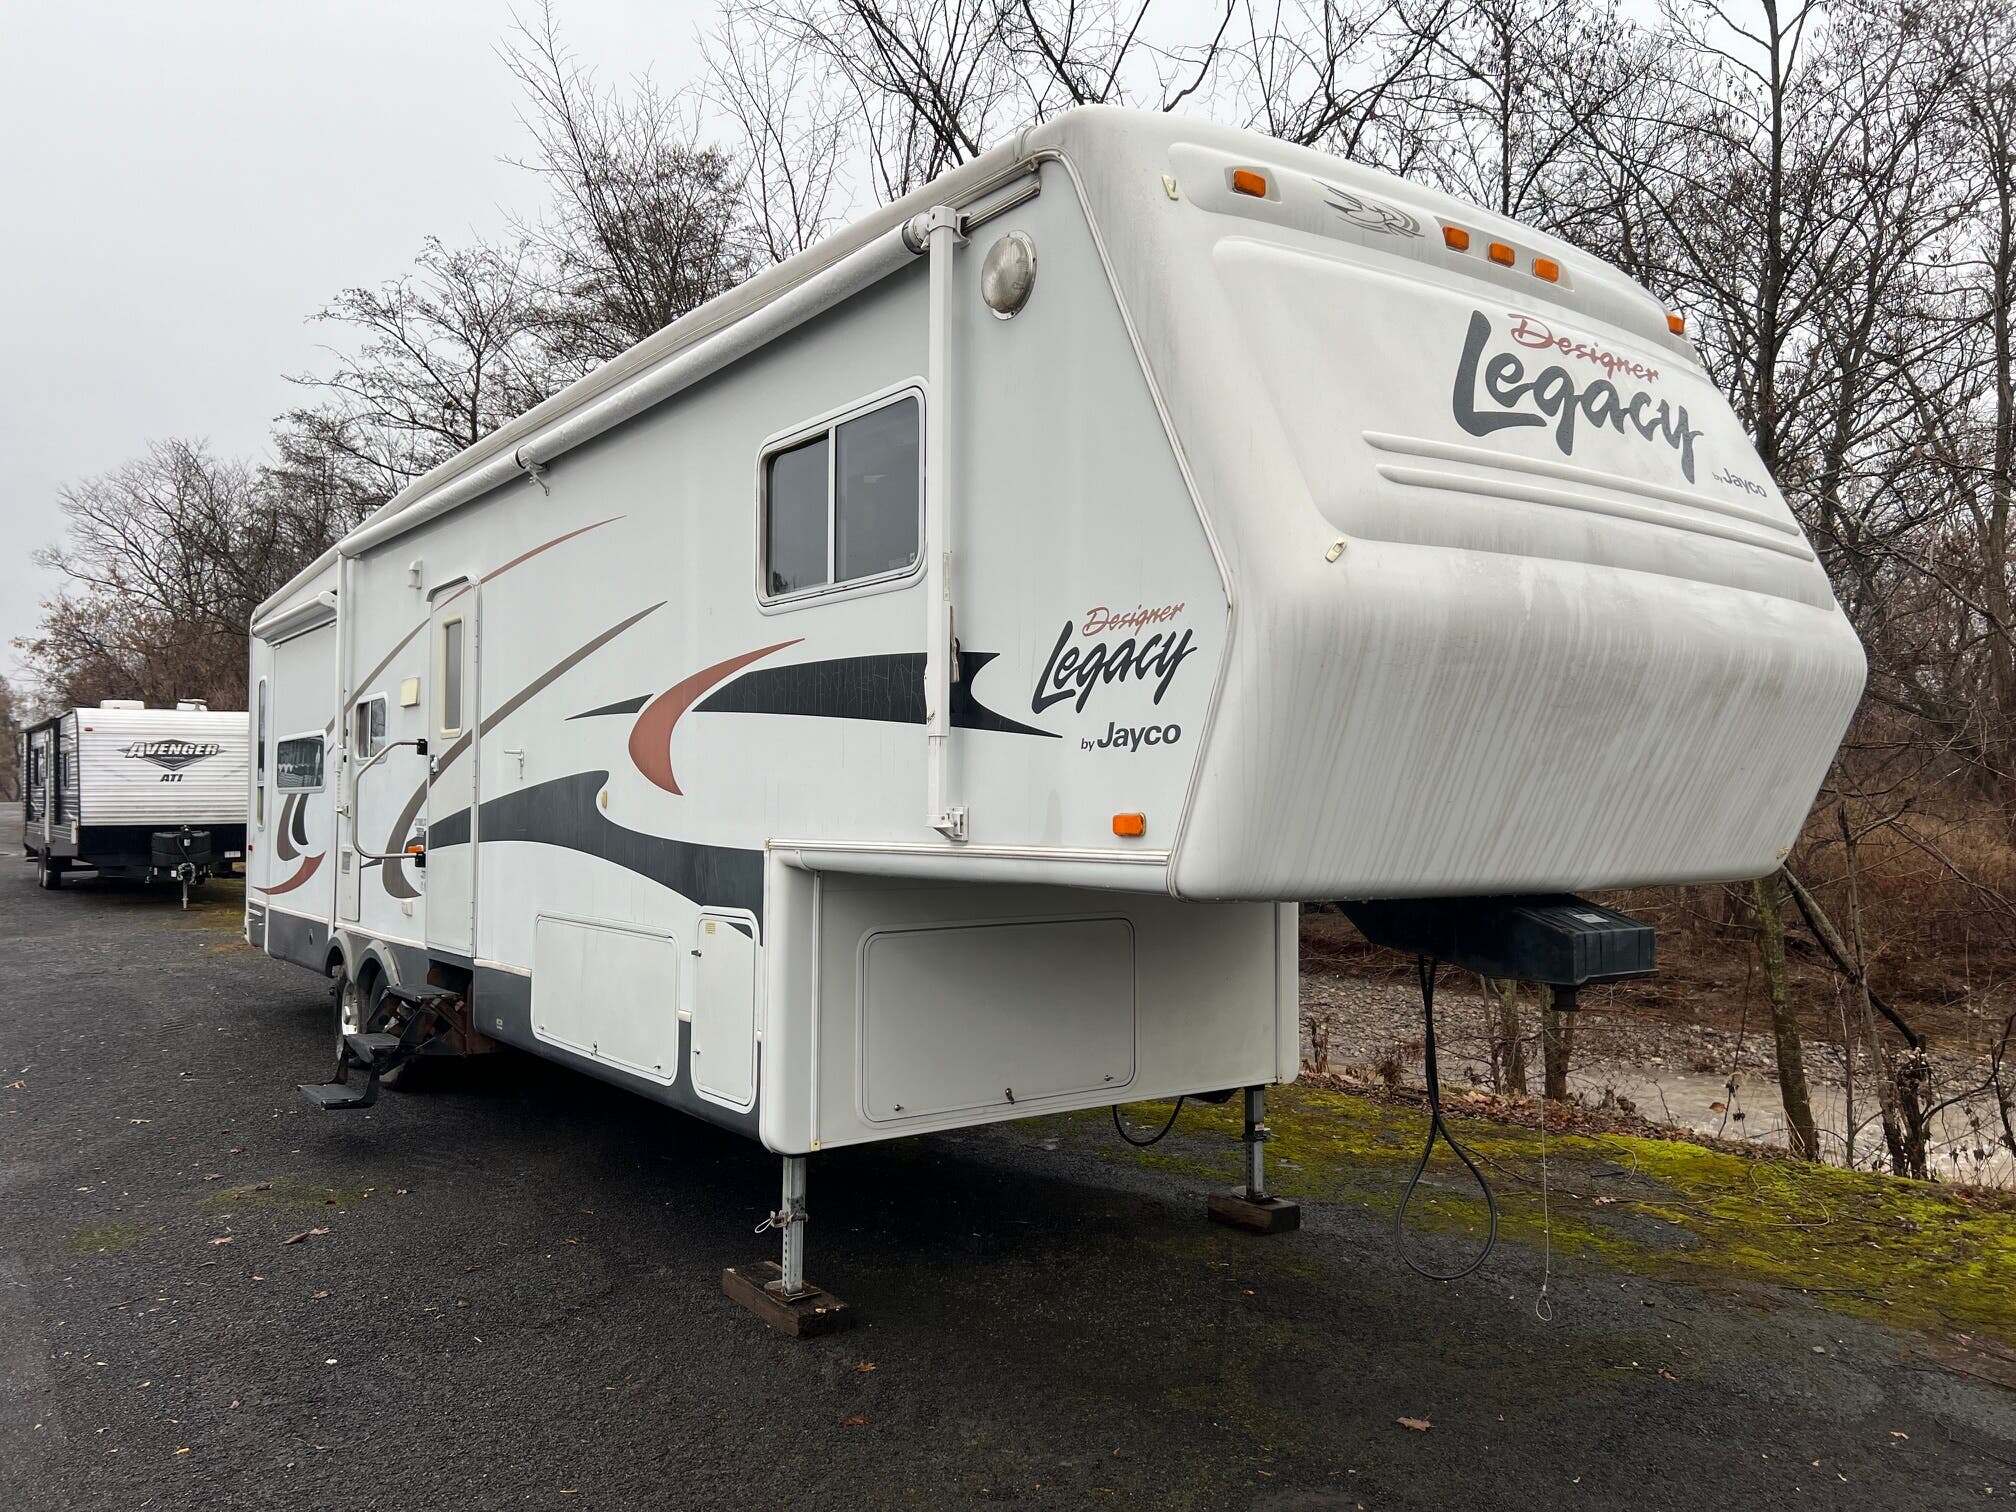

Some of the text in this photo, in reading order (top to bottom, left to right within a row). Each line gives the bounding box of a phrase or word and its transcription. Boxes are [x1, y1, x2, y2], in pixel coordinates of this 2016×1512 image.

[1507, 313, 1659, 384] Designer
[1452, 309, 1704, 485] Legacy
[1723, 467, 1768, 498] Jayco
[1082, 602, 1186, 637] Designer
[1031, 620, 1198, 714] Legacy
[125, 741, 220, 759] AVENGER
[1080, 721, 1182, 752] by Jayco
[160, 773, 184, 783] ATI
